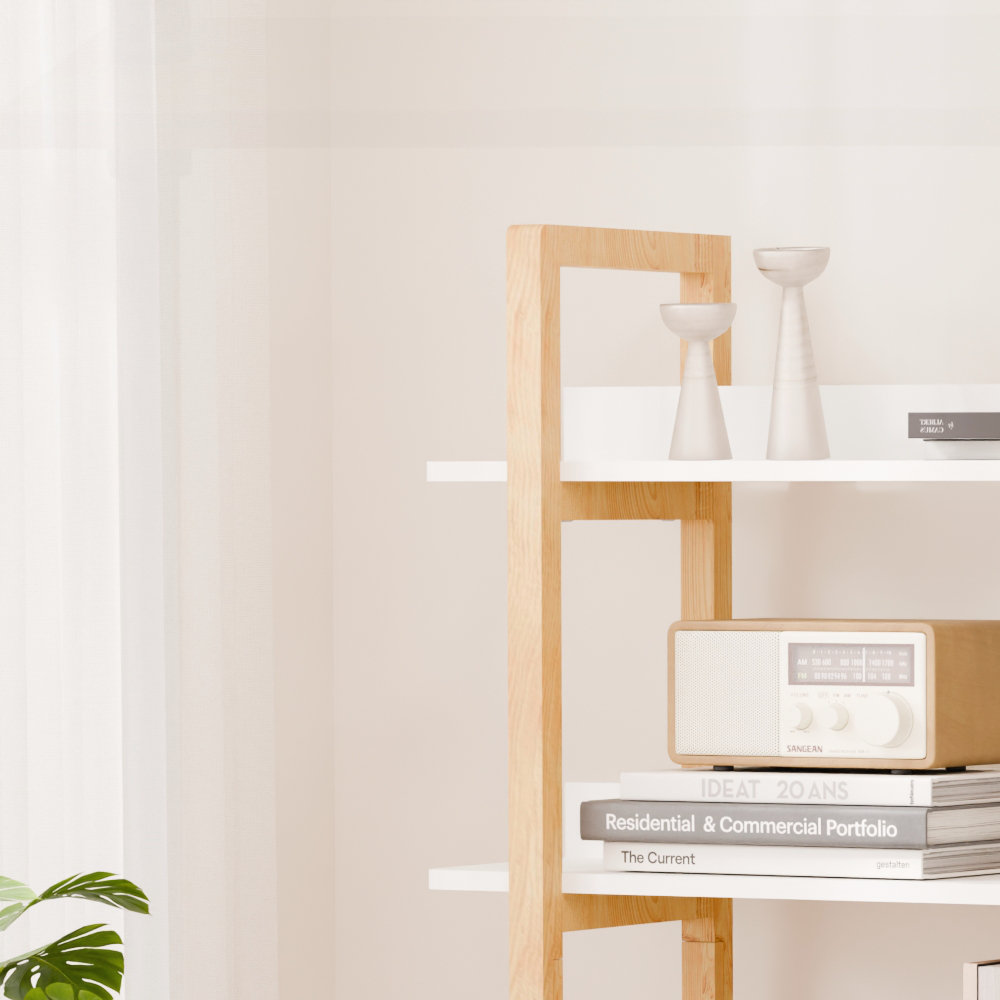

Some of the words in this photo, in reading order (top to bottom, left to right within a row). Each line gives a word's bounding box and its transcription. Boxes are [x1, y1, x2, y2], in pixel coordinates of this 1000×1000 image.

[701, 778, 761, 799] IDEAT
[776, 780, 805, 799] 20
[808, 780, 849, 800] ANS
[605, 813, 696, 832] Residential
[703, 816, 716, 833] &
[719, 816, 822, 835] Commercial
[826, 818, 898, 838] Portfolio
[621, 851, 645, 863] The
[647, 852, 696, 865] Current
[876, 860, 910, 870] gestalten
